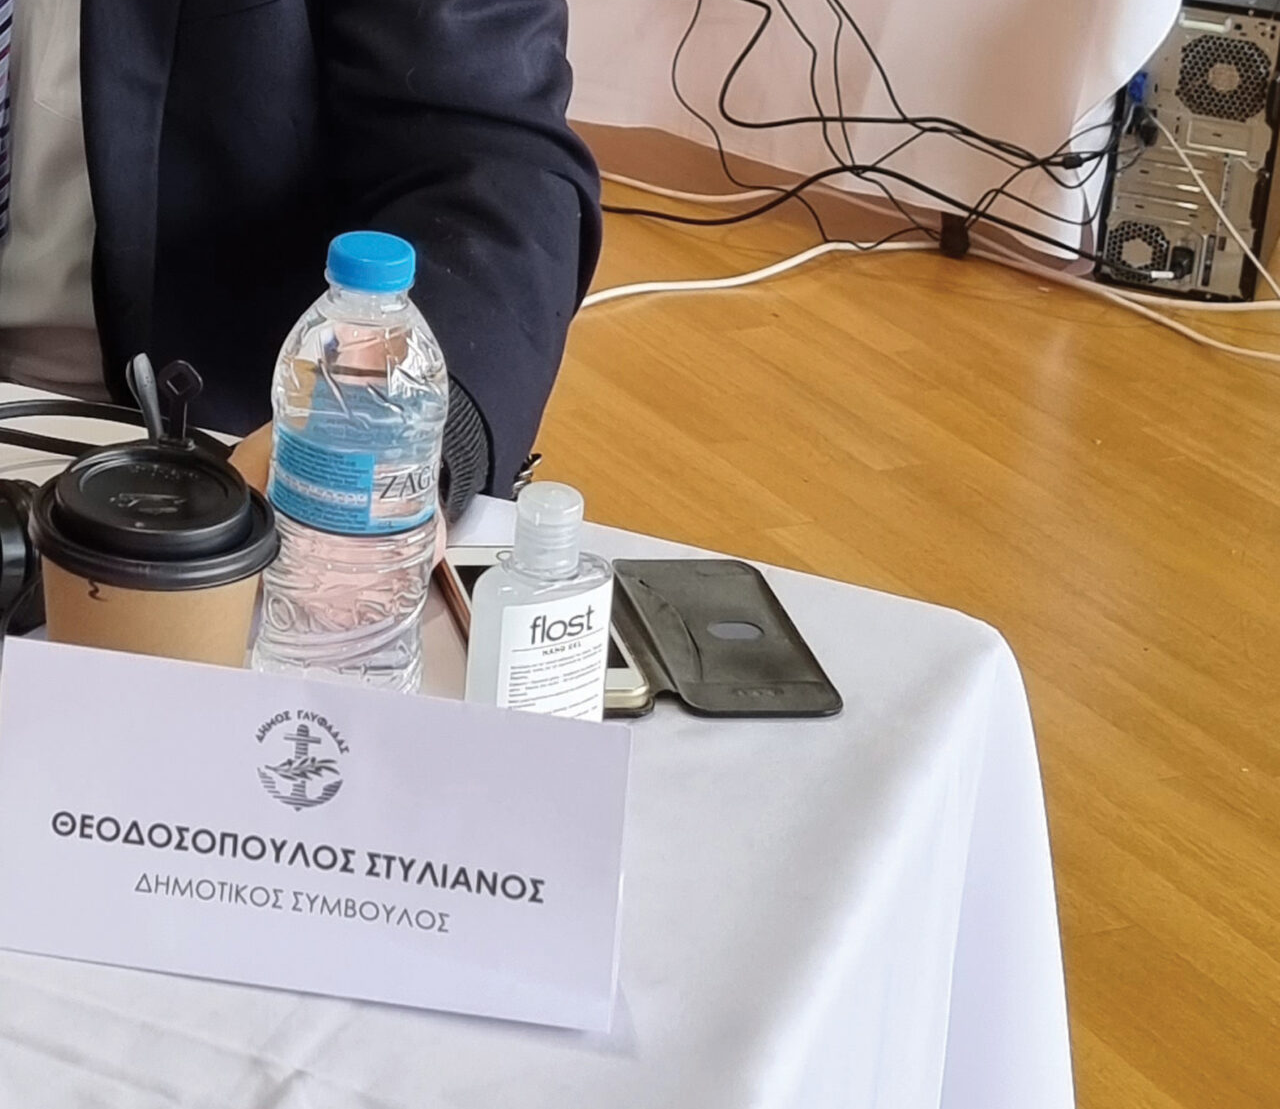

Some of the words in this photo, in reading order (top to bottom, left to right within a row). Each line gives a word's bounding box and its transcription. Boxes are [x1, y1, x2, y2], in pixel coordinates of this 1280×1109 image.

[530, 604, 596, 645] flost
[255, 709, 293, 744] ΔΗΜΟΣ
[51, 810, 357, 874] ΘΕΟΔΟΣΟΠΟΥΛΟΣ
[365, 851, 546, 904] ΣΤΥΛΙΑΝΟΣ
[134, 872, 284, 912] ΔΗΜΟΤΙΚΟΣ
[291, 890, 451, 934] ΣΥΜΒΟΥΛΟΣ
